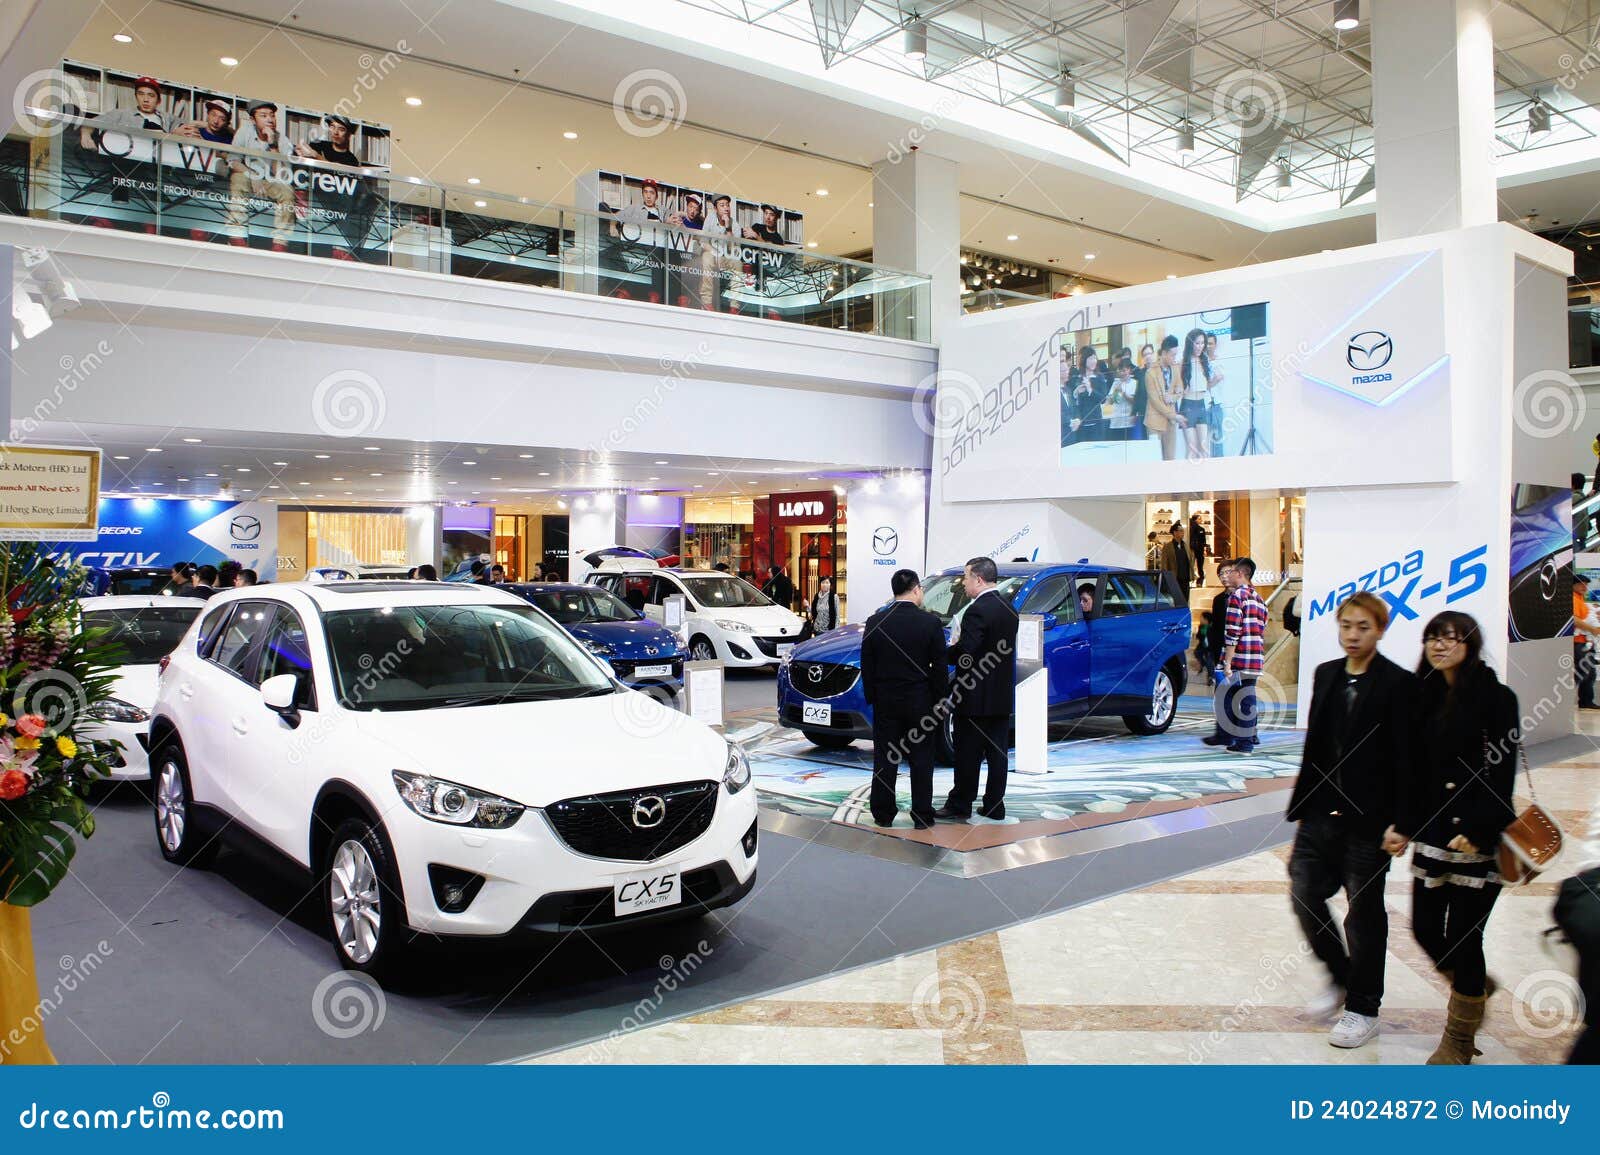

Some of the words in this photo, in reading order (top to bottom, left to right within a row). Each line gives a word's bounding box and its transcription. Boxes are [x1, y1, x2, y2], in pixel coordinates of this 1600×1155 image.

[112, 176, 137, 189] FIRST
[163, 184, 206, 201] PRODUCT
[660, 262, 688, 274] PODUCT
[13, 463, 46, 472] Motors
[48, 464, 70, 474] (HK)
[72, 465, 87, 474] Ltd
[5, 505, 30, 515] Hong
[32, 505, 55, 516] Kong
[56, 506, 88, 515] Limited
[778, 501, 824, 517] LLOYD
[98, 526, 144, 535] BEGINS
[1377, 544, 1488, 632] X-5
[804, 706, 829, 719] CX5
[618, 873, 677, 903] CX5
[633, 894, 670, 907] SKYACTIV
